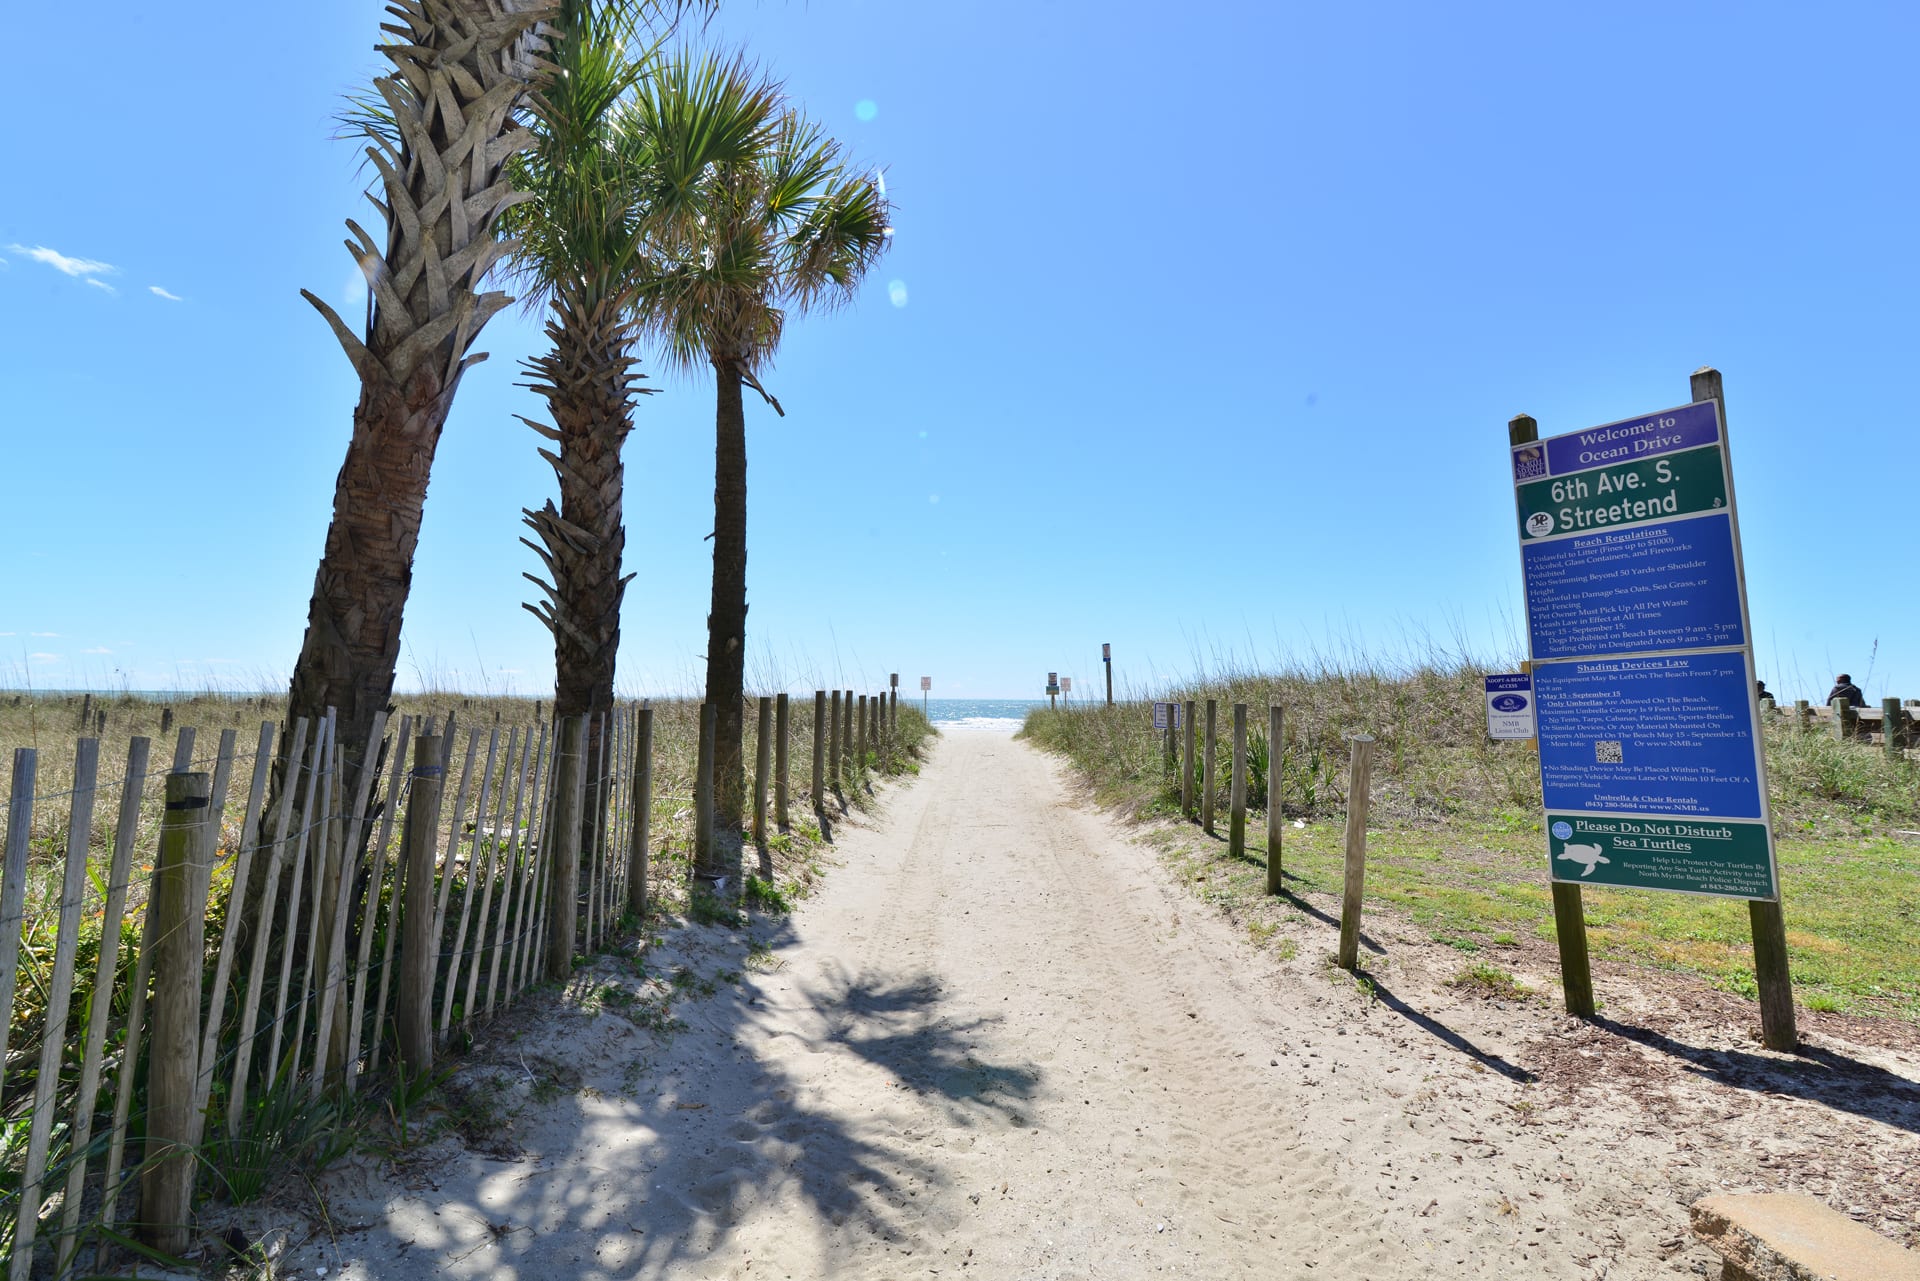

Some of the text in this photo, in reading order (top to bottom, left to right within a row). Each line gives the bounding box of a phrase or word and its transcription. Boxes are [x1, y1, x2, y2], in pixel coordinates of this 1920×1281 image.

[1580, 418, 1676, 447] Welcome to
[1580, 434, 1682, 464] Ocean Drive
[1552, 460, 1680, 504] 6th Ave. S.
[1560, 490, 1678, 530] Streetend
[1574, 529, 1667, 548] Beach Regulations
[1534, 552, 1567, 563] Unlawful
[1600, 545, 1623, 554] (Fines
[1648, 537, 1674, 547] $1000)
[1535, 560, 1564, 571] Alcohol,
[1565, 558, 1585, 567] Glass
[1587, 553, 1630, 563] Containers,
[1650, 544, 1693, 555] Fireworks
[1529, 569, 1566, 579] Prohibited
[1548, 576, 1588, 586] Swimming
[1590, 571, 1618, 581] Beyond
[1632, 566, 1656, 575] Yards
[1668, 561, 1707, 571] Shoulder
[1538, 593, 1571, 603] Unlawful
[1582, 591, 1614, 599] Damage
[1669, 581, 1696, 589] Grass,
[1662, 600, 1689, 608] Waste
[1570, 634, 1608, 642] Prohibited
[1623, 629, 1646, 638] Beach
[1648, 628, 1683, 636] Between
[1722, 623, 1737, 632] pm
[1572, 624, 1613, 634] September
[1549, 644, 1577, 652] Surfing
[1578, 643, 1597, 651] Only
[1609, 639, 1653, 648] Designated
[1714, 634, 1729, 642] pm
[1577, 663, 1619, 672] Shading
[1576, 821, 1616, 831] Please
[1620, 823, 1640, 833] Do
[1644, 824, 1671, 835] Not
[1675, 825, 1732, 838] Disturb
[1613, 837, 1692, 850] Sea Turtles
[1624, 862, 1657, 870] Reporting
[1713, 868, 1743, 877] Activity
[1734, 878, 1768, 886] Dispatch
